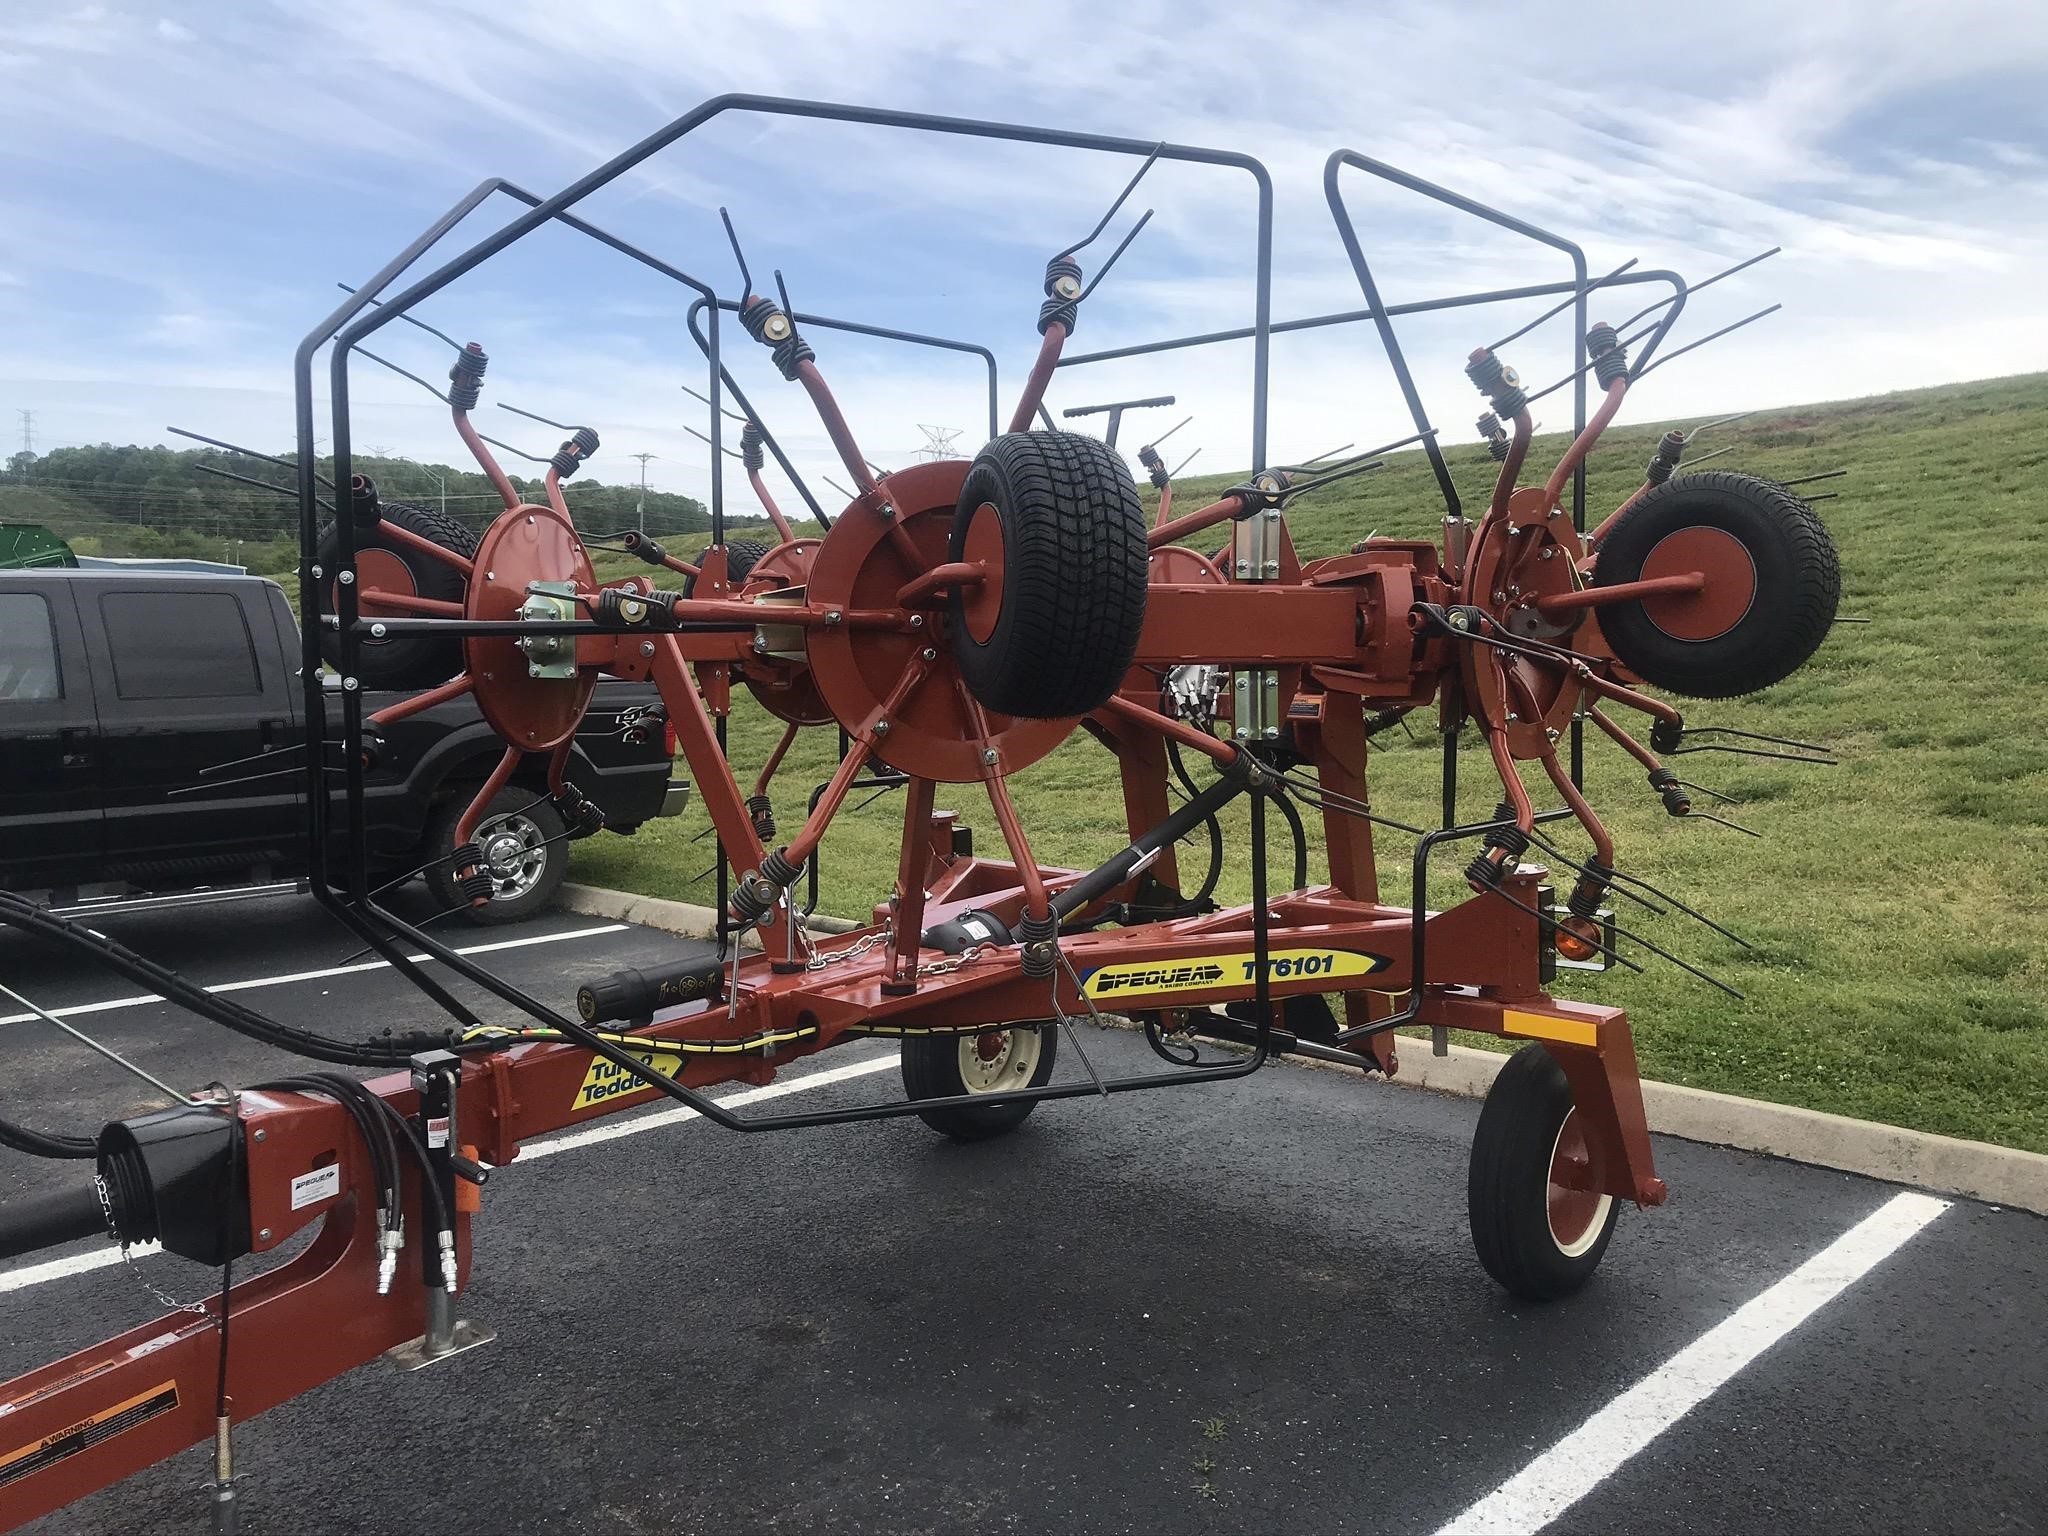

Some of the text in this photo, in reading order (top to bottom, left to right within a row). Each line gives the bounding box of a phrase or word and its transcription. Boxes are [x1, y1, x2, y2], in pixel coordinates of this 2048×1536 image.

[1113, 965, 1205, 989] PEQUEA
[592, 1054, 654, 1081] Tuo
[583, 1075, 651, 1103] Tedde
[49, 1418, 95, 1444] WARNING
